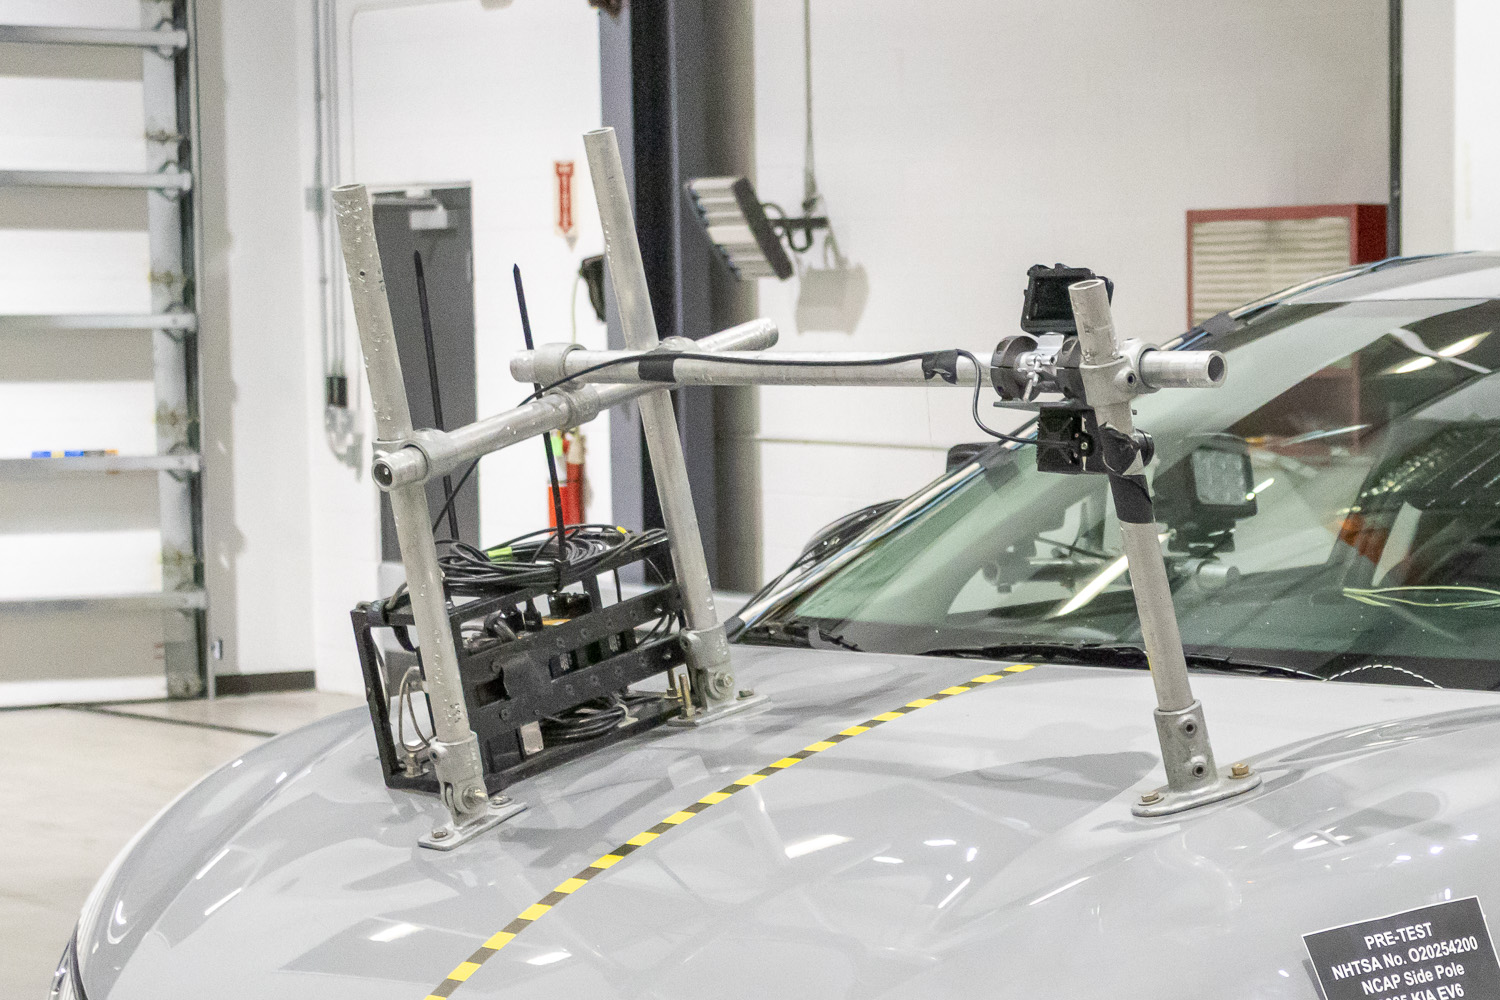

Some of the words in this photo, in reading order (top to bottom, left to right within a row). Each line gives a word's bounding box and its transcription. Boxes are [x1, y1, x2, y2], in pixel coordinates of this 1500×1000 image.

[1364, 922, 1433, 950] PRE-TEST
[1331, 956, 1384, 980] NHTSA
[1382, 953, 1408, 969] No.
[1408, 935, 1479, 963] O20254200
[1361, 974, 1401, 995] NCAP
[1404, 969, 1434, 986] Side
[1434, 962, 1465, 979] Pole
[1436, 983, 1465, 1000] EV6
